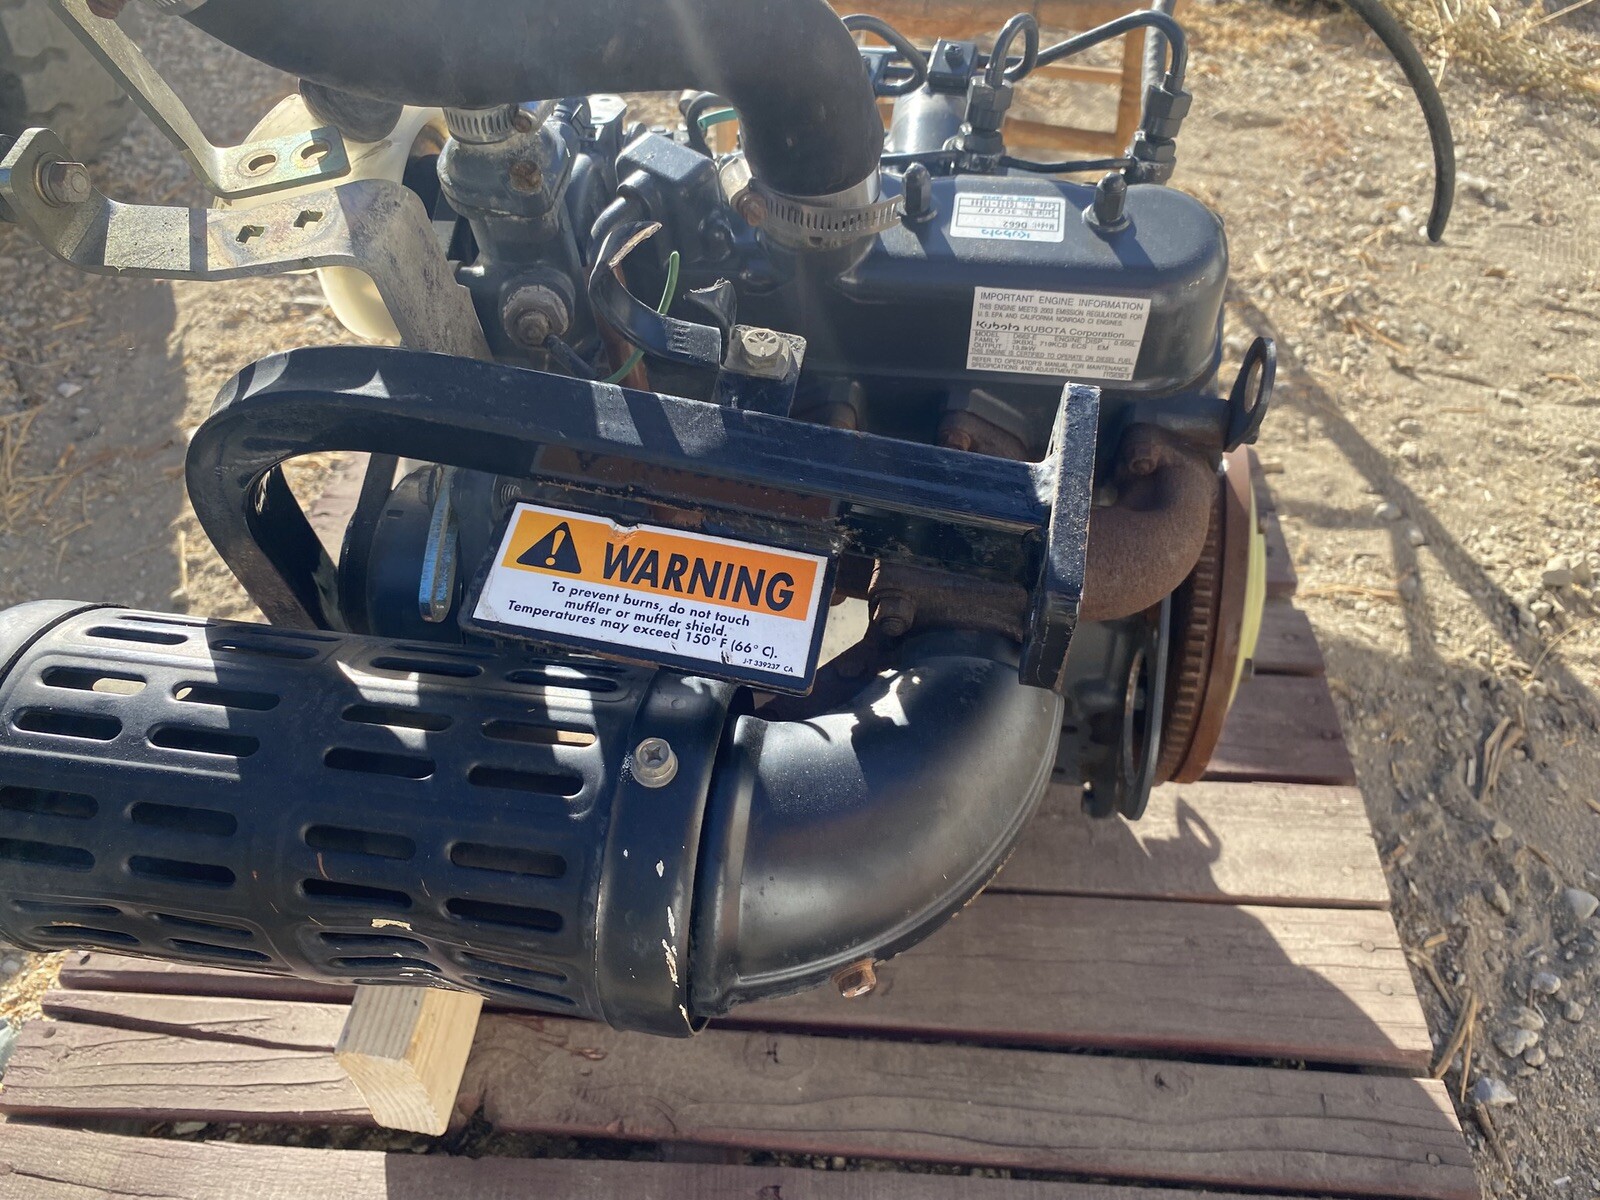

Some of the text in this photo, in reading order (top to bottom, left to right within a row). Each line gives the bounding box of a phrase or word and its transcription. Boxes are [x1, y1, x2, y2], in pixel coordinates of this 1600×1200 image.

[1003, 220, 1028, 229] D662
[980, 229, 1030, 239] Kubota
[980, 291, 1144, 311] IMPORTANT ENGINE INFORMATION
[979, 302, 992, 310] THIS
[994, 303, 1016, 311] ENGINE
[1018, 305, 1038, 313] MEETS
[1055, 308, 1084, 316] EMISSION
[1086, 310, 1128, 320] REGULATIONS
[1129, 313, 1143, 321] FOR
[991, 311, 1003, 319] EPA
[1005, 312, 1018, 320] AND
[1020, 313, 1054, 322] CALIFORNIA
[1055, 316, 1086, 324] NONROAD
[976, 320, 1125, 339] Kubota KUBOTA Corporation
[973, 342, 1001, 350] OUTPUT
[974, 336, 1000, 344] FAMILY
[1054, 335, 1081, 344] ENGINE
[971, 362, 1019, 370] SPECIFICATIONS
[972, 356, 992, 364] REFER
[1086, 364, 1130, 373] MAINTENANCE
[602, 541, 795, 612] WARNING
[551, 581, 751, 627] To prevent burns, do not touch
[564, 599, 728, 637] muffler or muffler shield.
[507, 599, 778, 660] Temperatures may exceed 150° F (66° C).
[753, 659, 781, 671] 339237
[783, 665, 794, 673] CA
